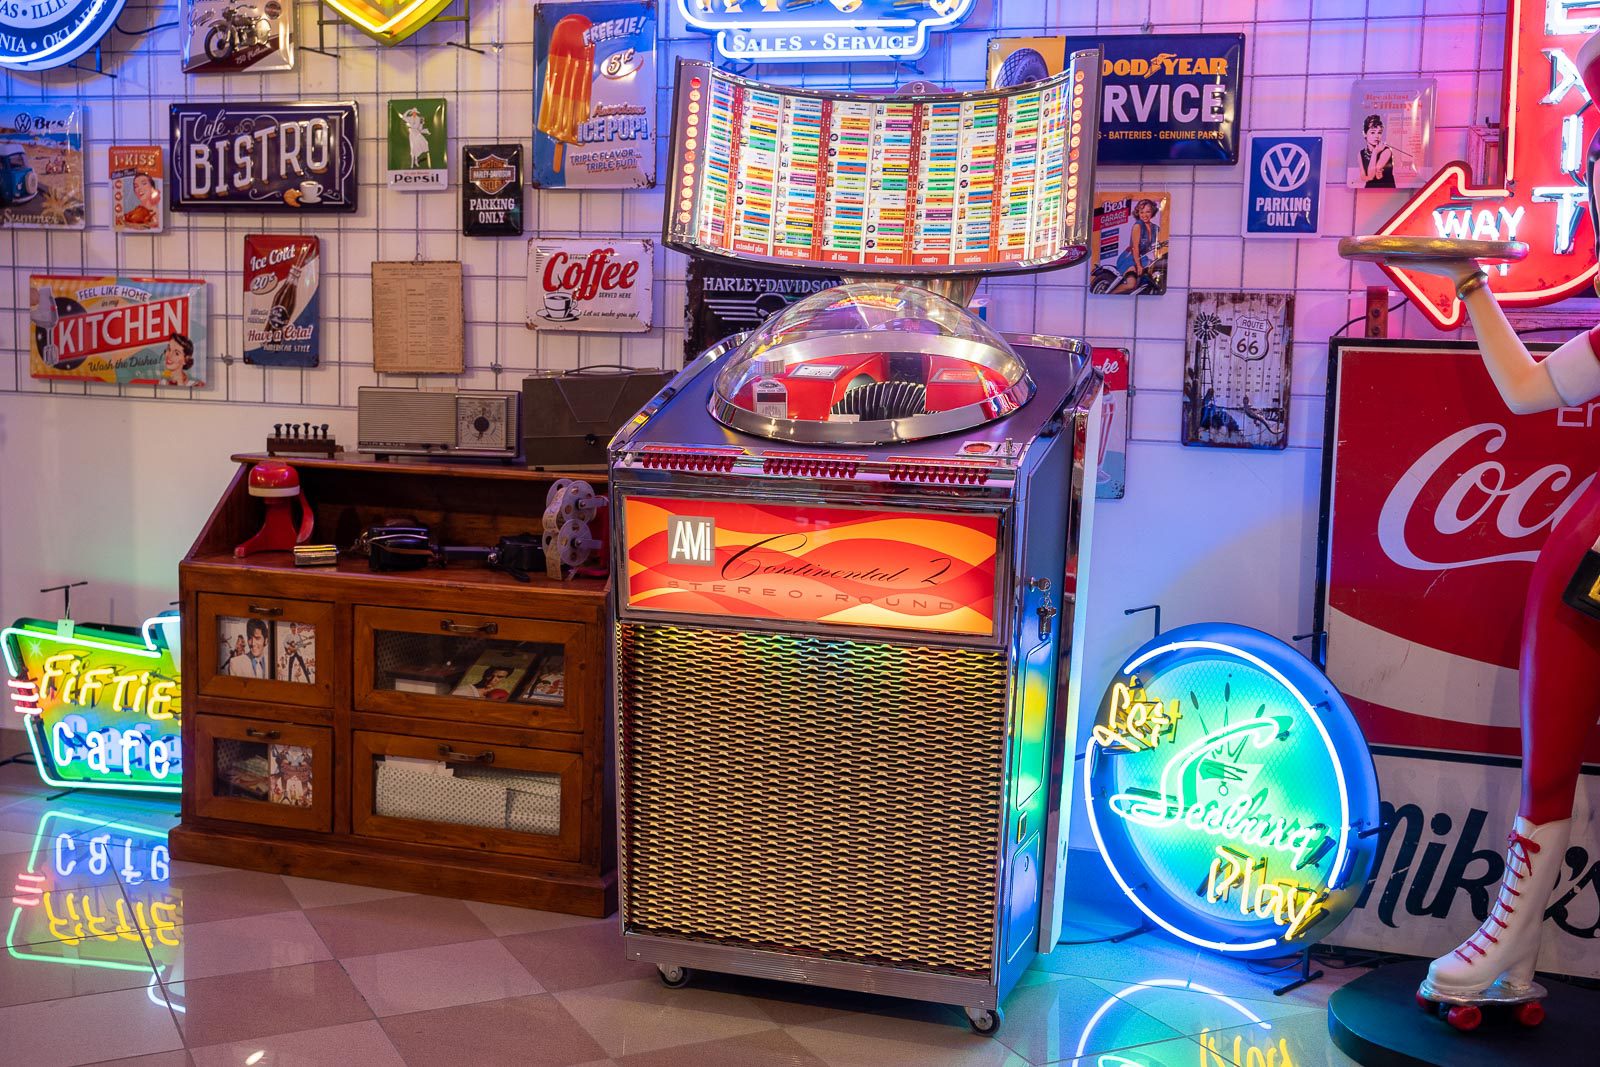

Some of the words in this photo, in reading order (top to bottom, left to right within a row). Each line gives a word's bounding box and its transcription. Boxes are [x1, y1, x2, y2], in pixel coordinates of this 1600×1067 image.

[582, 16, 646, 46] FREEZIE!
[732, 35, 802, 52] SALES
[823, 32, 916, 50] SERVICE
[1102, 57, 1228, 77] OODYEAR
[1103, 83, 1226, 123] RVICE
[193, 109, 228, 144] Café
[577, 120, 605, 143] ICE
[607, 118, 648, 141] POP!
[1108, 131, 1152, 140] BATTERIES
[1159, 131, 1195, 140] GENUINE
[1197, 131, 1225, 140] PARTS
[124, 153, 155, 167] KISS
[189, 118, 330, 199] BISTRO
[570, 152, 598, 164] TRIPLE
[586, 160, 613, 171] TRIPLE
[394, 173, 440, 183] Persil
[469, 198, 515, 211] PARKING
[1103, 198, 1127, 213] Best
[1255, 196, 1311, 213] PARKING
[479, 212, 506, 224] ONLY
[1266, 212, 1299, 227] ONLY
[250, 256, 267, 271] Ice
[269, 244, 296, 265] Cold
[542, 248, 639, 301] Coffee
[79, 290, 98, 300] FEEL
[101, 286, 119, 296] LIKE
[121, 288, 148, 301] HOME
[59, 299, 183, 356] KITCHEN
[248, 329, 272, 342] Have
[283, 323, 313, 341] Cola!
[1241, 320, 1264, 330] ROUTE
[1236, 338, 1259, 355] 66
[88, 360, 114, 372] Wash
[115, 360, 128, 369] the
[129, 352, 163, 367] Dishes!
[720, 533, 911, 583] Continental
[920, 557, 952, 585] 2
